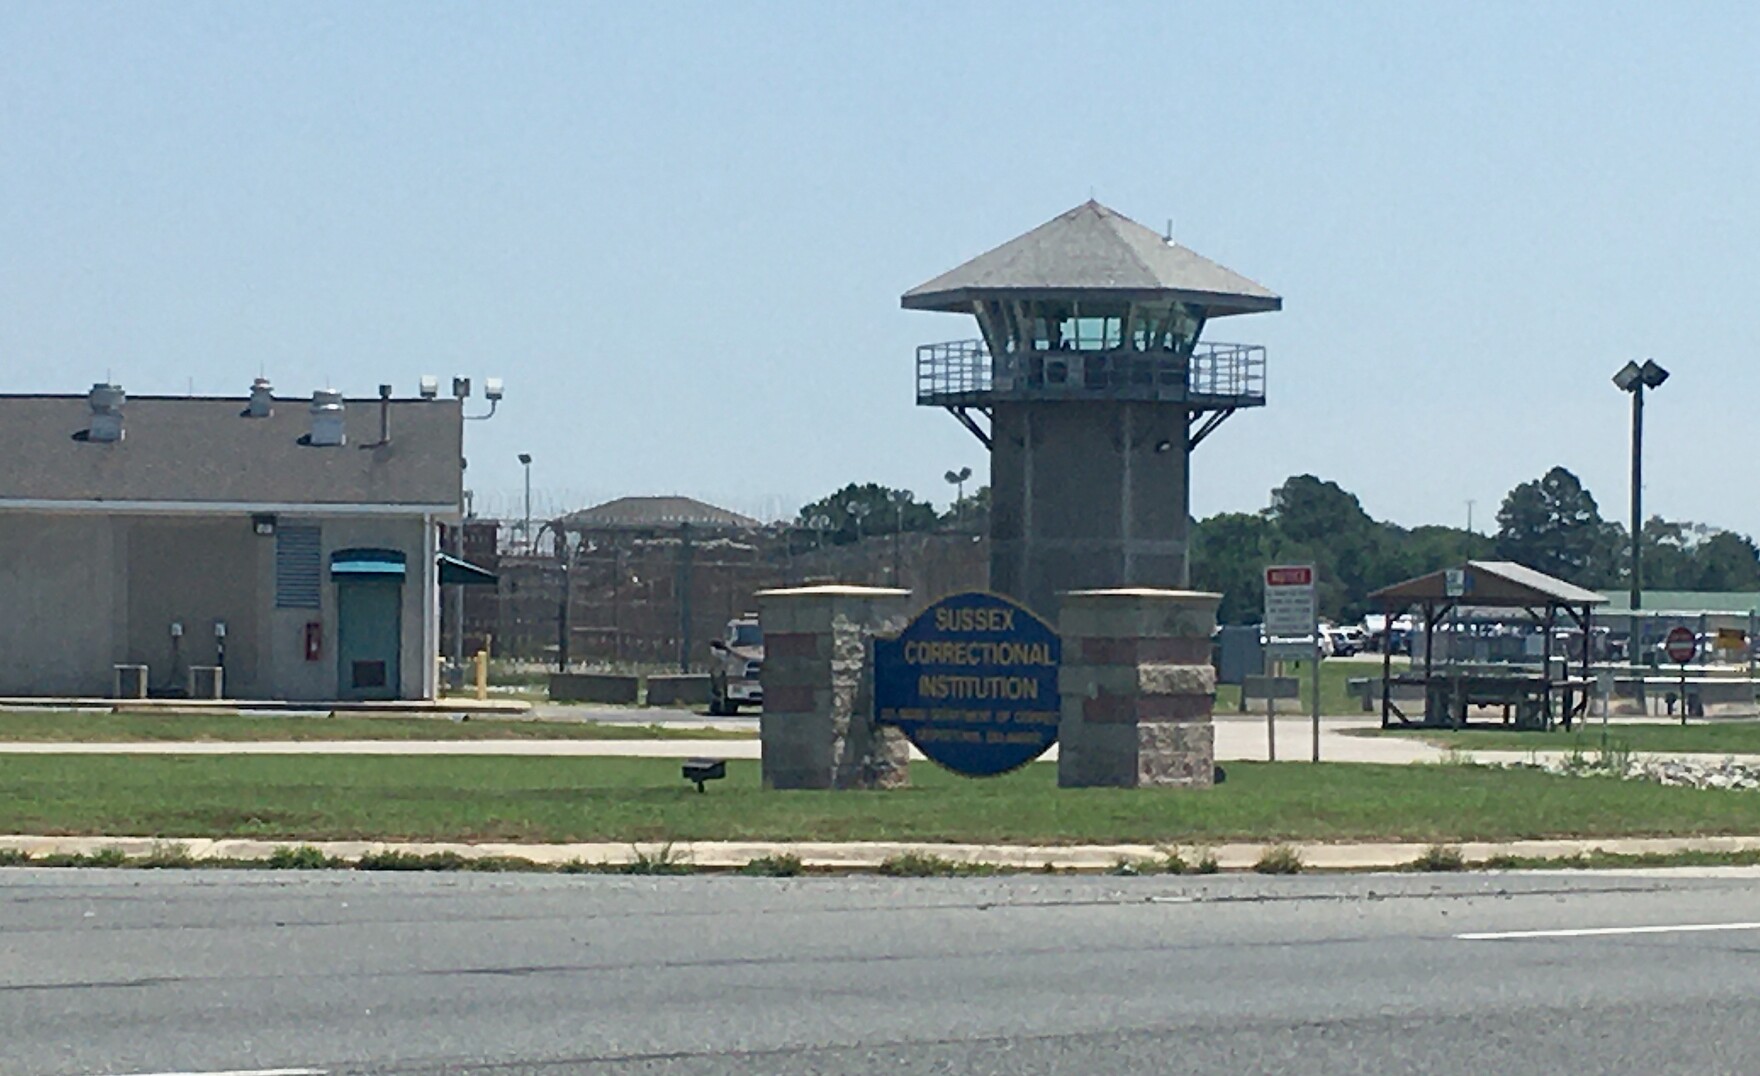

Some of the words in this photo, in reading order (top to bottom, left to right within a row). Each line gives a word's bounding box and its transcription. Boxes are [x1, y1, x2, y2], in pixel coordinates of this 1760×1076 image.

[935, 608, 1015, 632] SUSSEX
[904, 641, 1057, 666] CORRECTIONAL
[918, 674, 1038, 700] INSTITUTION
